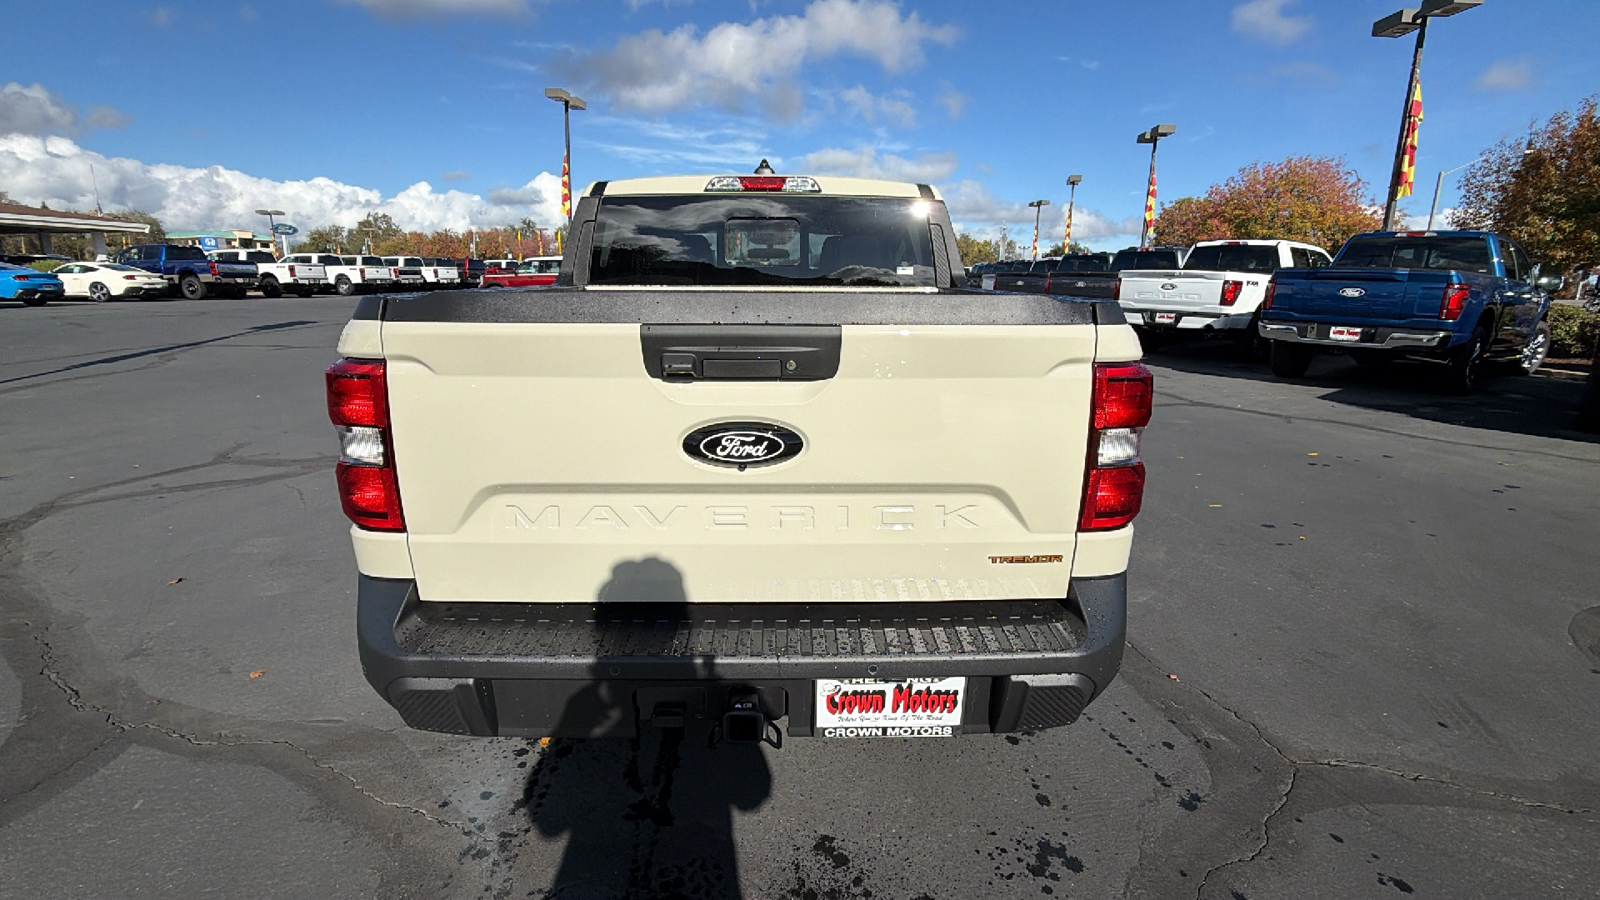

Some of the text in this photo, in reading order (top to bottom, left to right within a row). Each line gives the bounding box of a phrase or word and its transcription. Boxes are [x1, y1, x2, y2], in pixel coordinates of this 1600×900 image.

[716, 435, 769, 457] Ford
[504, 505, 980, 530] MAVERICK
[987, 554, 1063, 564] TREMOR
[826, 685, 957, 715] Crown Motors
[824, 726, 953, 738] CROWN MOTORS
